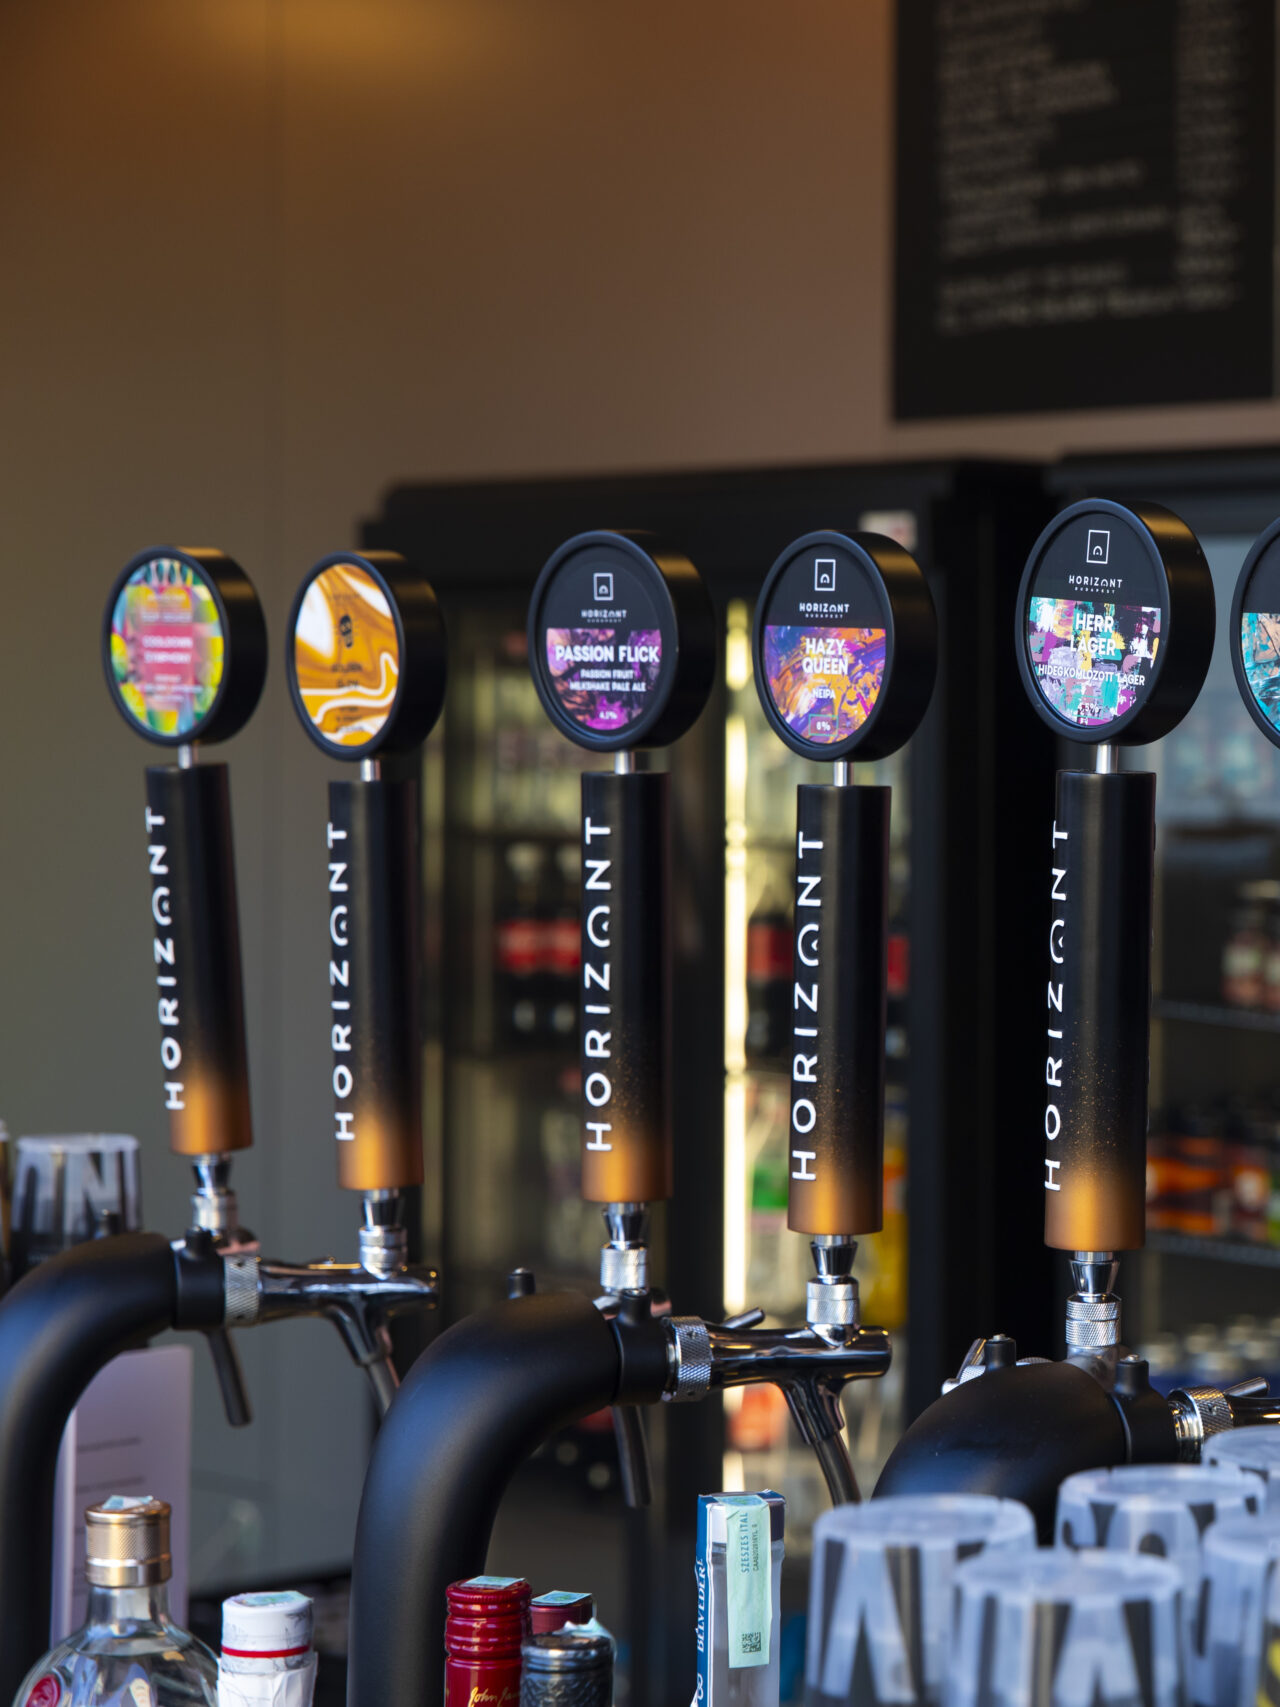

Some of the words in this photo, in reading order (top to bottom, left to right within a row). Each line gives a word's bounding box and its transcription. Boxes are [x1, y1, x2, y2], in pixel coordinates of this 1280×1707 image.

[1075, 613, 1115, 632] HERR
[555, 645, 614, 663] PASSION
[618, 646, 660, 663] FLICK
[805, 637, 846, 655] HAZY
[1070, 636, 1116, 656] LAGER
[580, 669, 611, 679] PASSION
[612, 669, 634, 680] FRUIT
[802, 657, 849, 675] QUEEN
[570, 681, 611, 691] MILKSHAKE
[612, 681, 630, 692] PALE
[632, 682, 646, 692] ALE
[1117, 670, 1145, 686] LAGER
[811, 688, 836, 699] NEIPA
[740, 1512, 748, 1532] ITAL
[741, 1534, 750, 1573] SZESZES
